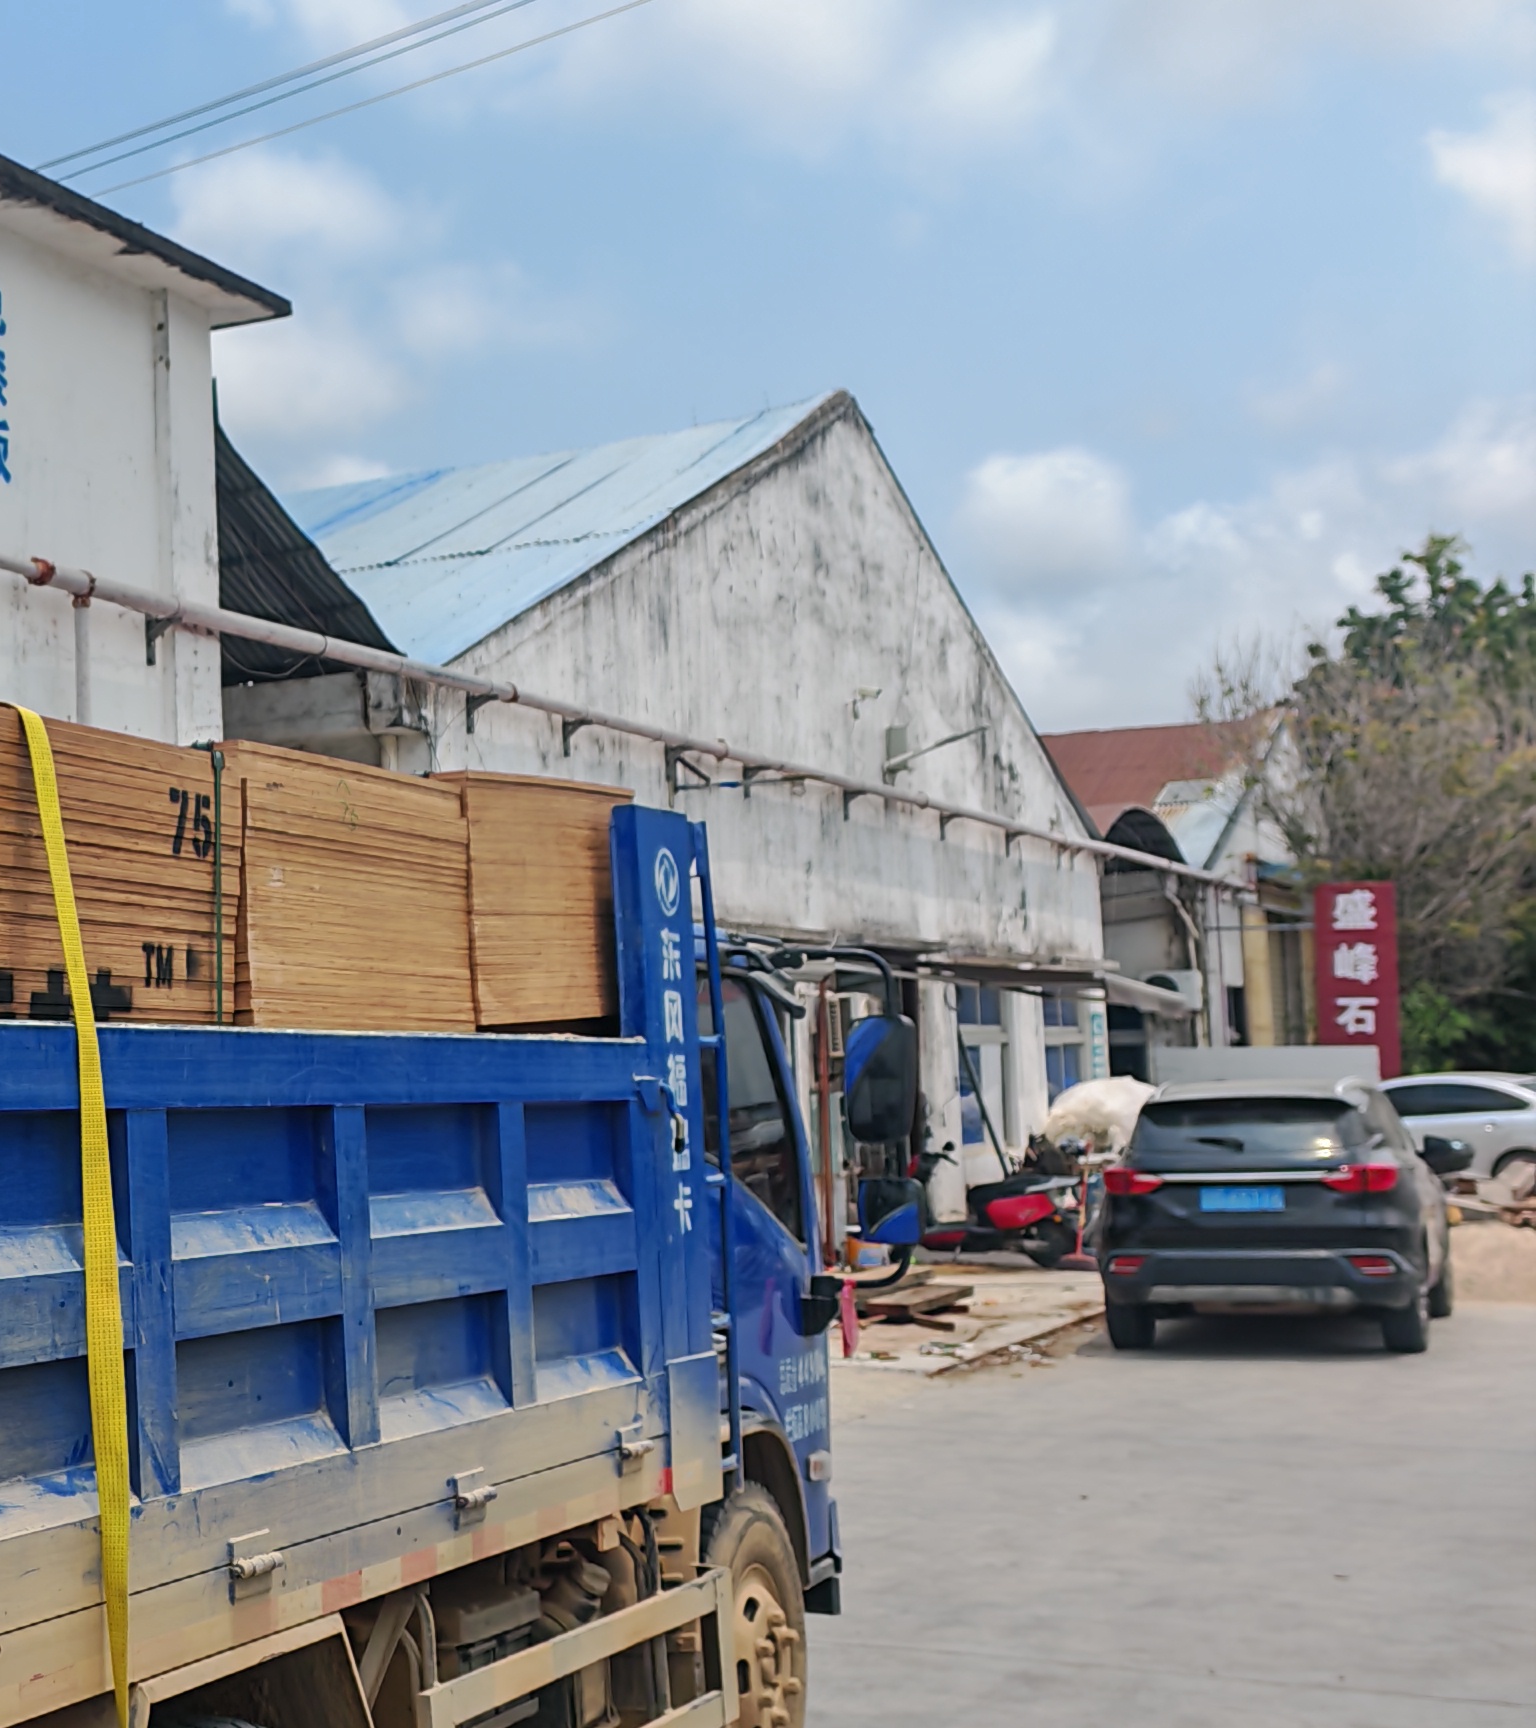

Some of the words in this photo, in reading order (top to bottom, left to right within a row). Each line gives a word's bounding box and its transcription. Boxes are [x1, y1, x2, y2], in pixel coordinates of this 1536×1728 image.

[169, 787, 213, 858] 75
[1331, 889, 1380, 1035] 盛峰石
